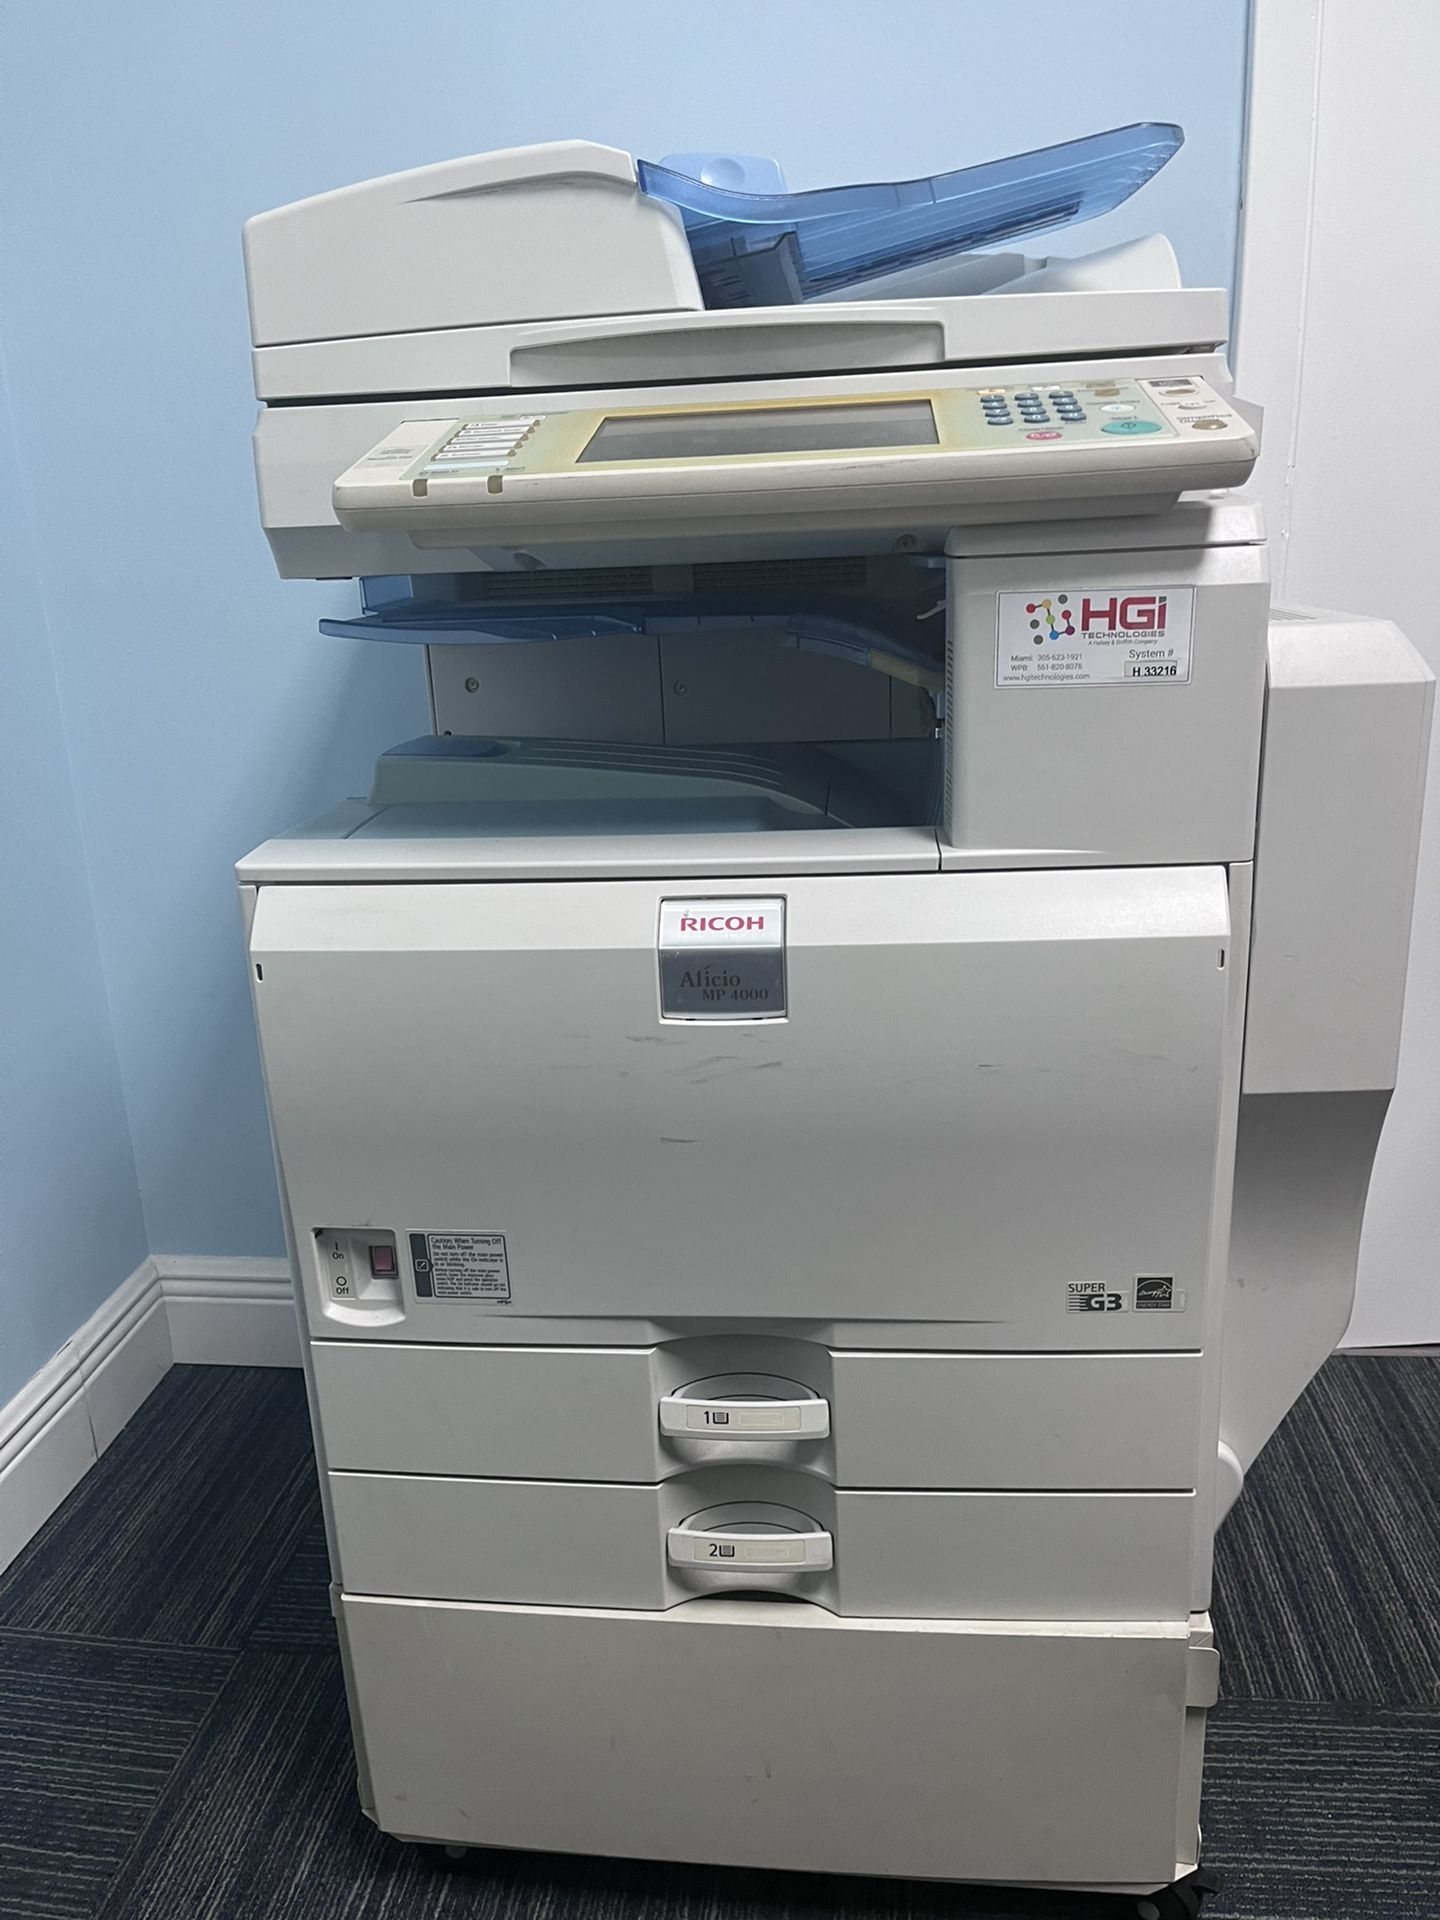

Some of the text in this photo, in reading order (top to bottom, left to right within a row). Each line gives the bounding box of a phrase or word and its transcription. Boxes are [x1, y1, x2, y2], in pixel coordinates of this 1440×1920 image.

[1081, 631, 1165, 639] TECHNOLOGIES
[1129, 648, 1174, 660] System #
[1132, 665, 1177, 677] H 33216
[1003, 673, 1091, 682] www.hgitechnologies.com
[680, 916, 765, 931] RICOH
[702, 989, 769, 1001] MP 4000
[470, 1238, 491, 1246] Turning
[332, 1252, 344, 1260] On
[336, 1287, 349, 1295] Off
[1068, 1282, 1106, 1293] SUPER
[1084, 1293, 1123, 1311] G3
[703, 1410, 710, 1425] 1
[708, 1543, 718, 1558] 2
